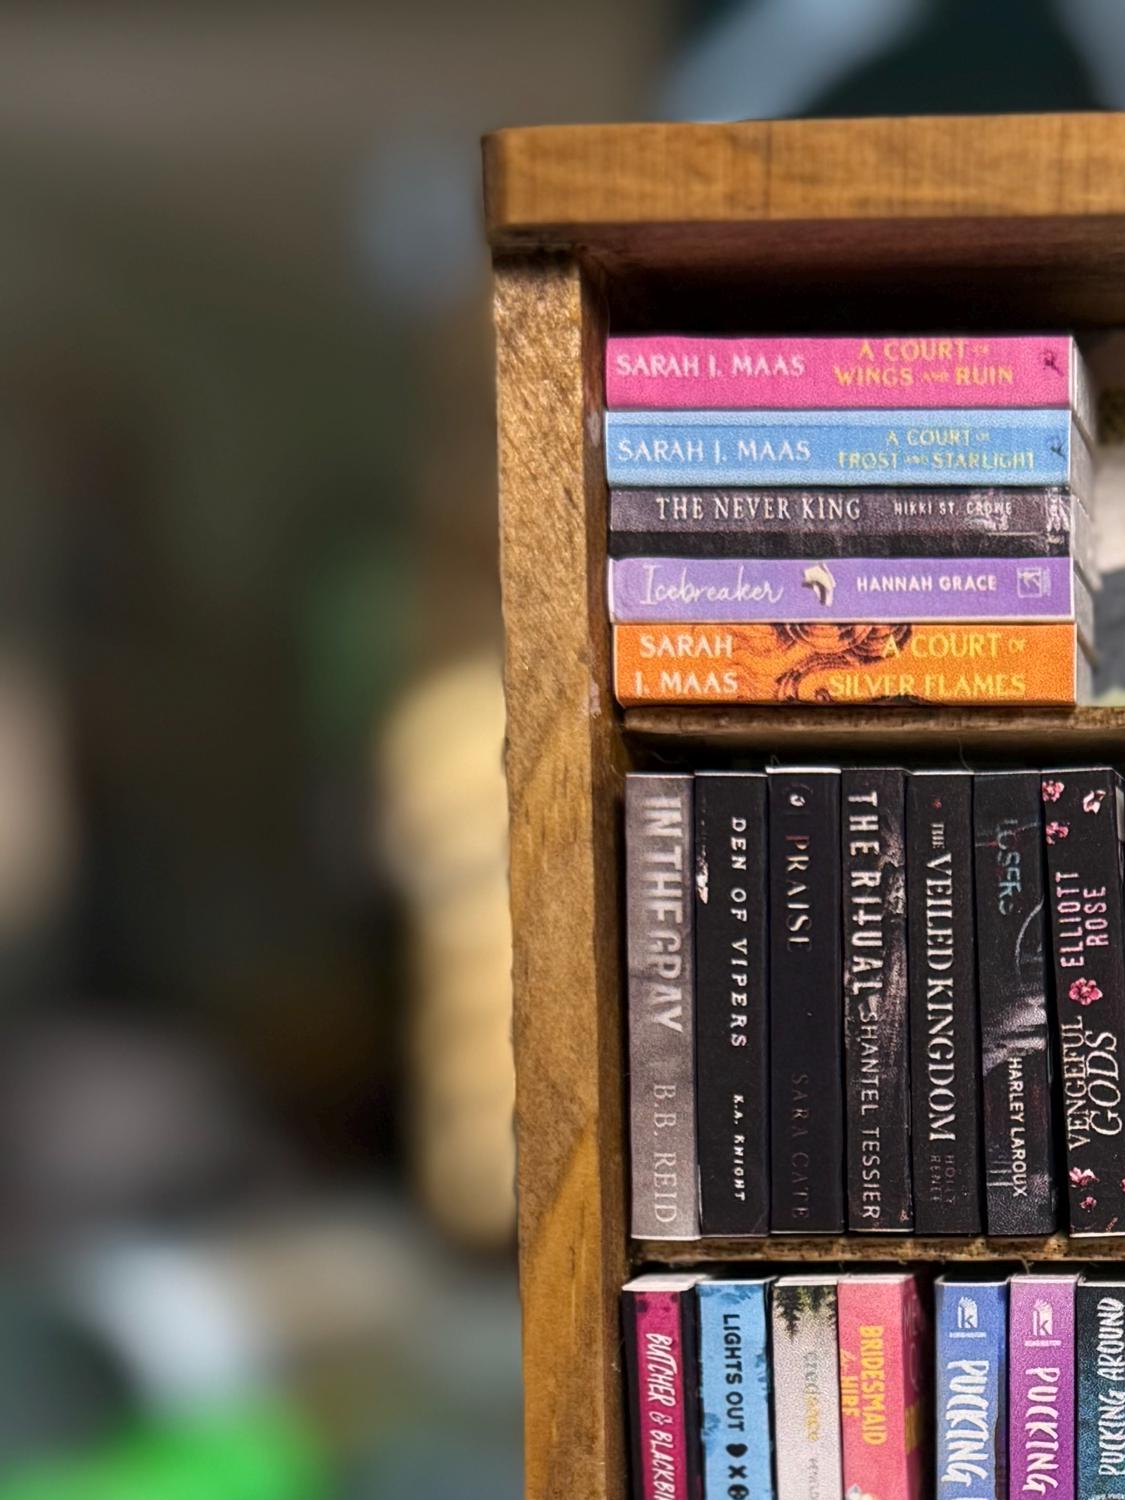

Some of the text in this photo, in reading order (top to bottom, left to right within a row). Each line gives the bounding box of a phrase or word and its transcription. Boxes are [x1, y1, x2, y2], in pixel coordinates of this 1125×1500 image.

[615, 353, 707, 377] SARAH
[730, 353, 805, 376] MAAS
[833, 366, 915, 386] WINGS
[955, 365, 1013, 386] RUIN
[860, 340, 875, 361] A
[884, 339, 970, 361] COURT
[617, 440, 703, 463] SARAH
[737, 440, 812, 462] MAAS
[837, 450, 899, 470] FROST
[931, 449, 1036, 470] STARLIGHT
[886, 430, 900, 447] A
[906, 429, 971, 447] COURT
[655, 498, 862, 521] THE NEVER KING
[893, 501, 933, 515] NIKKI
[639, 562, 787, 608] Icebreaker
[856, 574, 997, 593] HANNAH GRACE
[638, 635, 734, 659] SARAH
[882, 633, 900, 654] A
[910, 632, 1004, 659] COURT
[659, 672, 739, 696] MAAS
[827, 672, 1026, 698] SILVER FLAMES
[785, 834, 813, 953] PRAISE
[848, 789, 884, 996] THE RITUAL
[1055, 871, 1085, 968] ELLIOTT
[1083, 885, 1110, 946] ROSE
[730, 816, 749, 1048] DEN OF VIPERS
[925, 821, 957, 1143] THE VEILED KINGDOM
[791, 1072, 810, 1138] SARA
[860, 1010, 881, 1220] SHANTEL TESSIER
[1061, 1015, 1091, 1152] VENGEFUL
[1084, 1030, 1123, 1137] GODS
[1006, 1057, 1028, 1197] HARLEY LAROUX
[653, 1153, 679, 1223] REID
[733, 1134, 746, 1202] KNIGHT
[645, 1332, 678, 1403] BUTCHER
[722, 1313, 744, 1385] LIGHTS
[726, 1391, 745, 1432] OUT
[859, 1324, 888, 1445] BRIDESMAID
[648, 1410, 671, 1426] &
[942, 1359, 990, 1488] PUCKING
[1022, 1365, 1060, 1494] PUCKING
